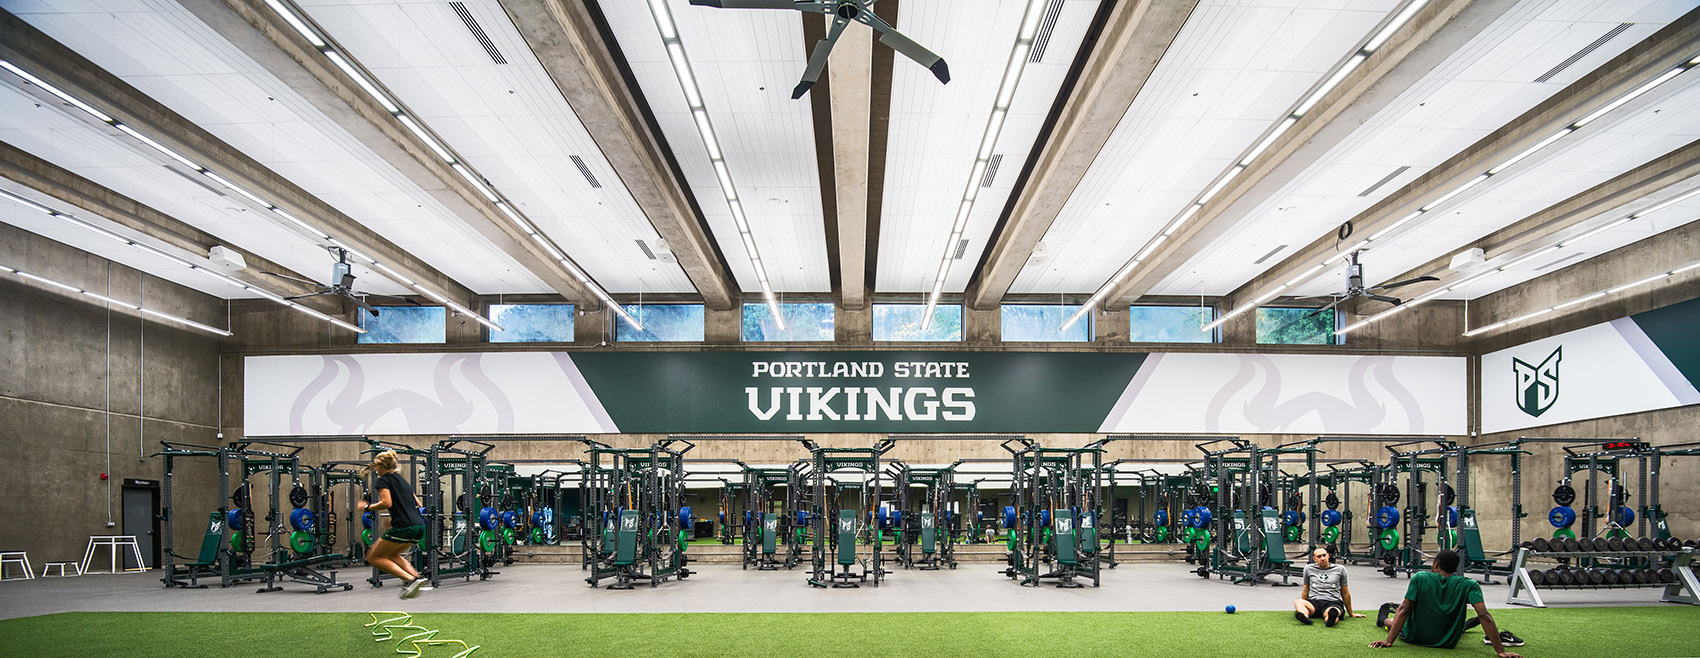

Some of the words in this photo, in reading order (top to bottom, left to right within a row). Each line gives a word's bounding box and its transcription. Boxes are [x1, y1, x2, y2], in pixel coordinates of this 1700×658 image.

[752, 361, 884, 378] PORTLAND
[894, 362, 970, 378] STATE
[745, 387, 976, 421] VIKINGS
